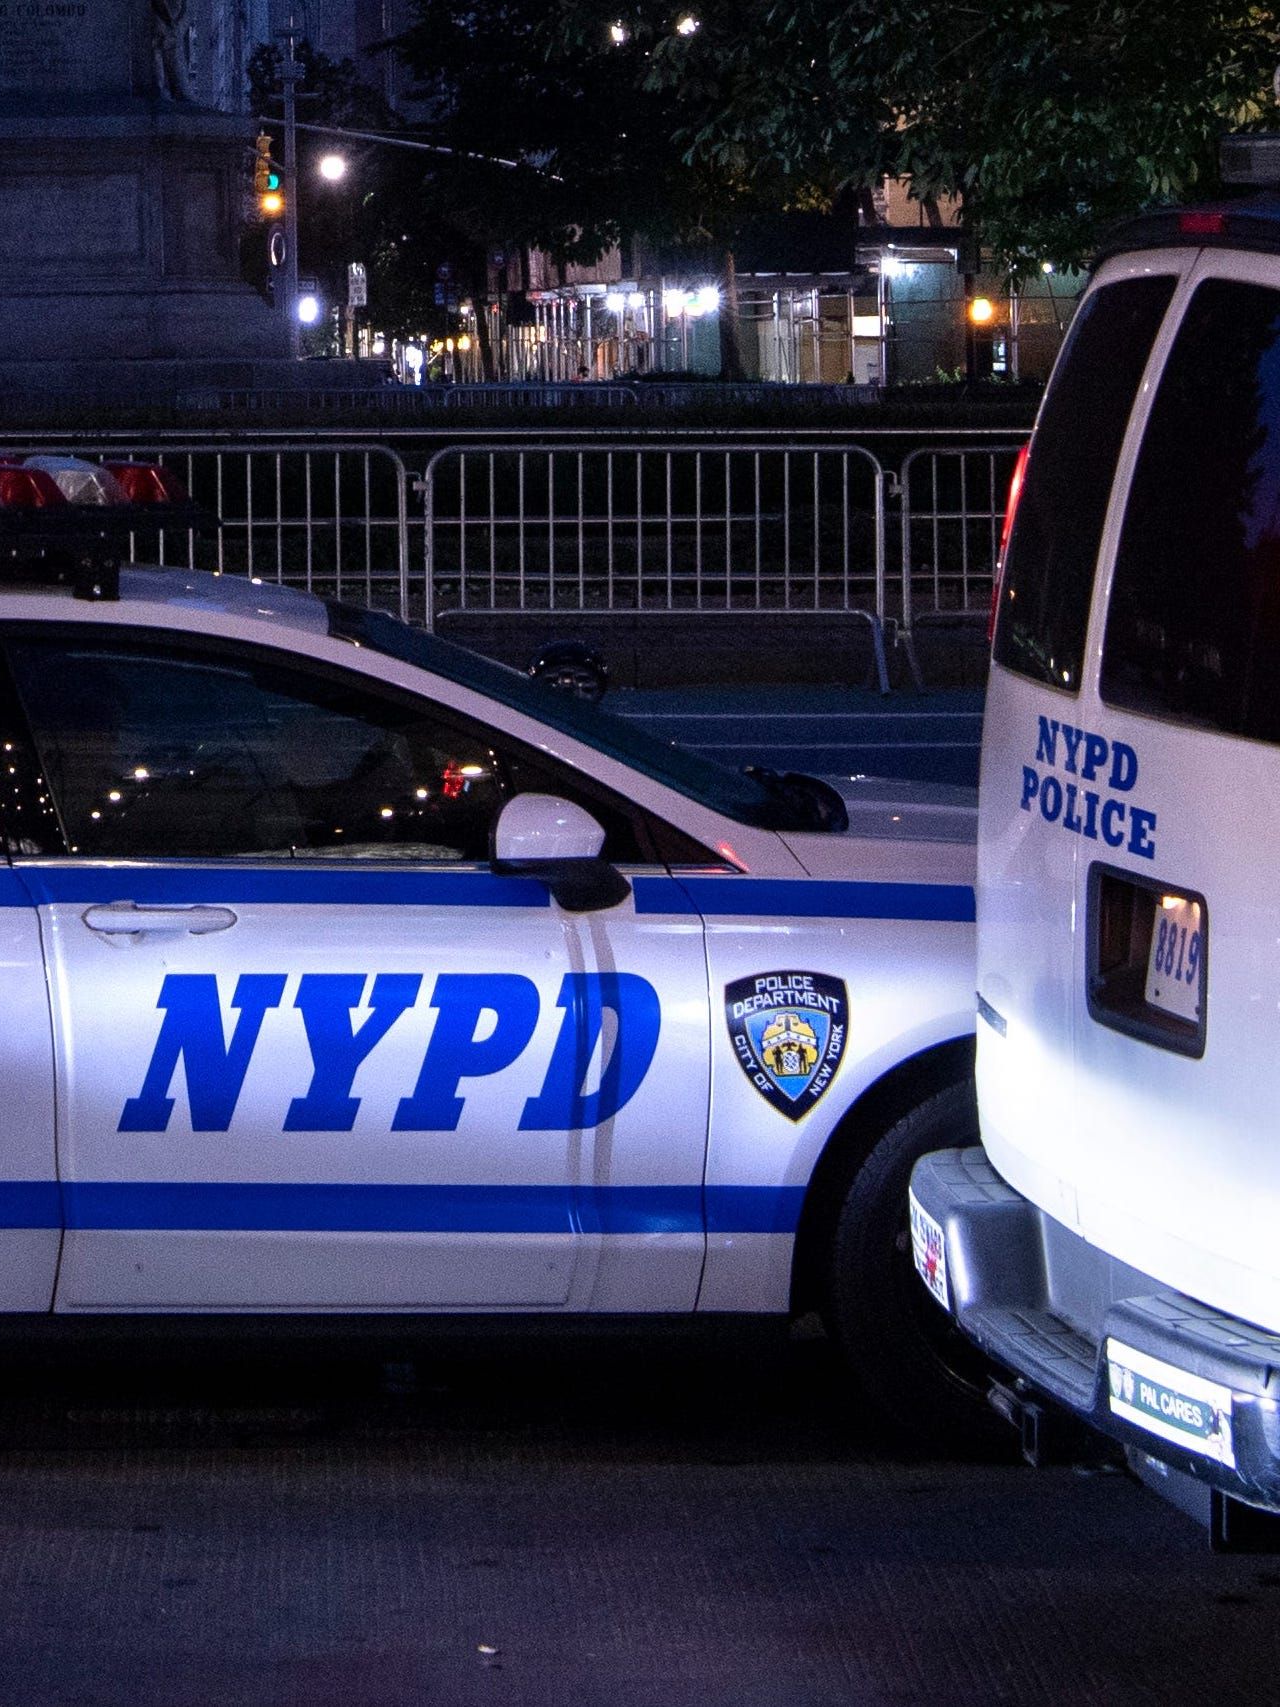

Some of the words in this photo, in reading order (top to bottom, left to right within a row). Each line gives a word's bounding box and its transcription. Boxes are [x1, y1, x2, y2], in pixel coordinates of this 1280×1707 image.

[1036, 715, 1138, 792] NYPD
[1020, 766, 1157, 860] POLICE
[755, 975, 814, 993] POLICE
[1155, 918, 1200, 985] 8819
[733, 990, 840, 1019] DEPARTMENT
[117, 973, 661, 1132] NYPD
[735, 1034, 759, 1070] CITY
[754, 1073, 774, 1092] OF
[809, 1064, 833, 1096] NEW
[826, 1024, 843, 1061] YORK
[1140, 1382, 1160, 1410] PAL
[1160, 1392, 1203, 1428] CARES
